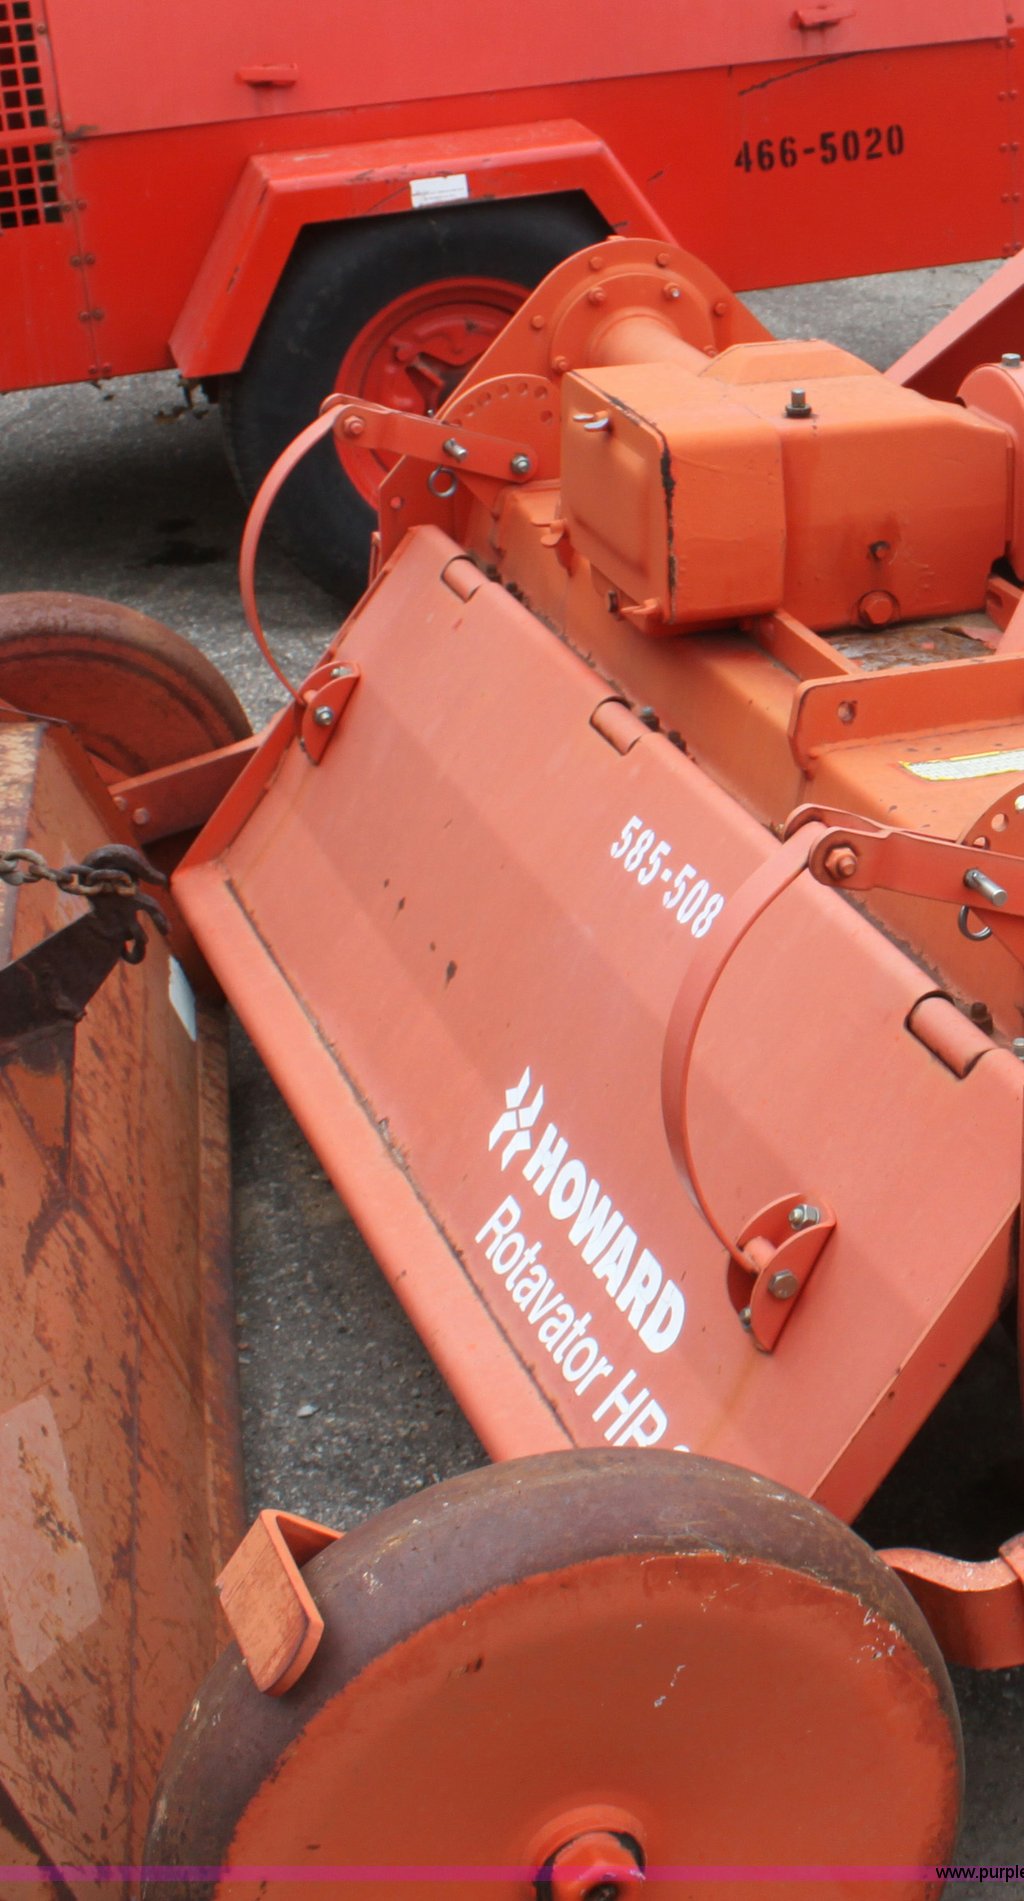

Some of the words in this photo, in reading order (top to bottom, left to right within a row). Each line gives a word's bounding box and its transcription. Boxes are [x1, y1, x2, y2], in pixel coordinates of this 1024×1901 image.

[734, 124, 905, 173] 466-5020
[610, 815, 725, 938] 585-508
[474, 1194, 614, 1397] Rotavator
[521, 1122, 686, 1354] HOWARD
